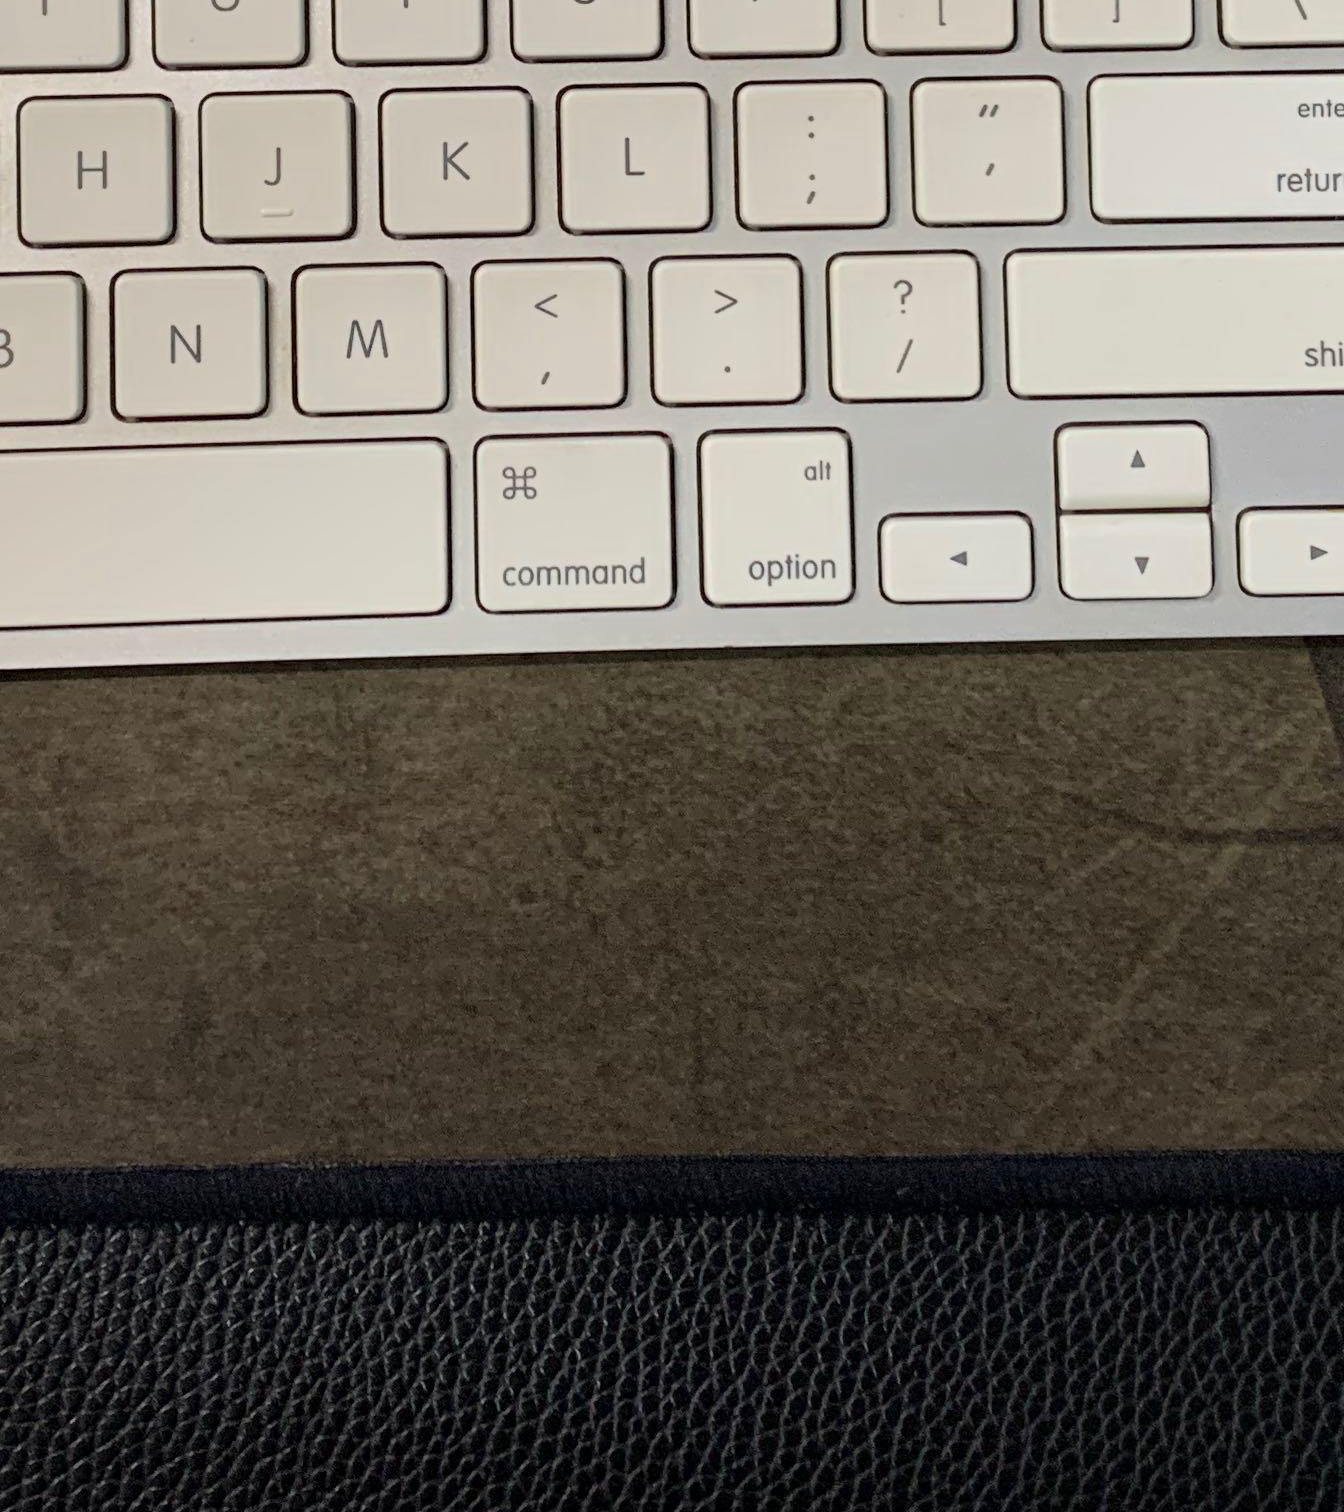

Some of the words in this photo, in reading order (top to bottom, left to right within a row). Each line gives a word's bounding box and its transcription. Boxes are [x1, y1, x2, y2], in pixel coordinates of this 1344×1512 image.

[77, 150, 108, 190] H
[262, 145, 283, 188] J
[442, 141, 471, 181] K
[623, 135, 647, 178] L
[805, 172, 817, 206] ;
[533, 292, 559, 319] <
[713, 288, 739, 315] >
[892, 278, 914, 316] ?
[170, 324, 202, 365] N
[346, 319, 389, 360] M
[895, 337, 915, 375] /
[802, 458, 833, 482] alt
[502, 556, 646, 587] command
[748, 553, 837, 587] option
